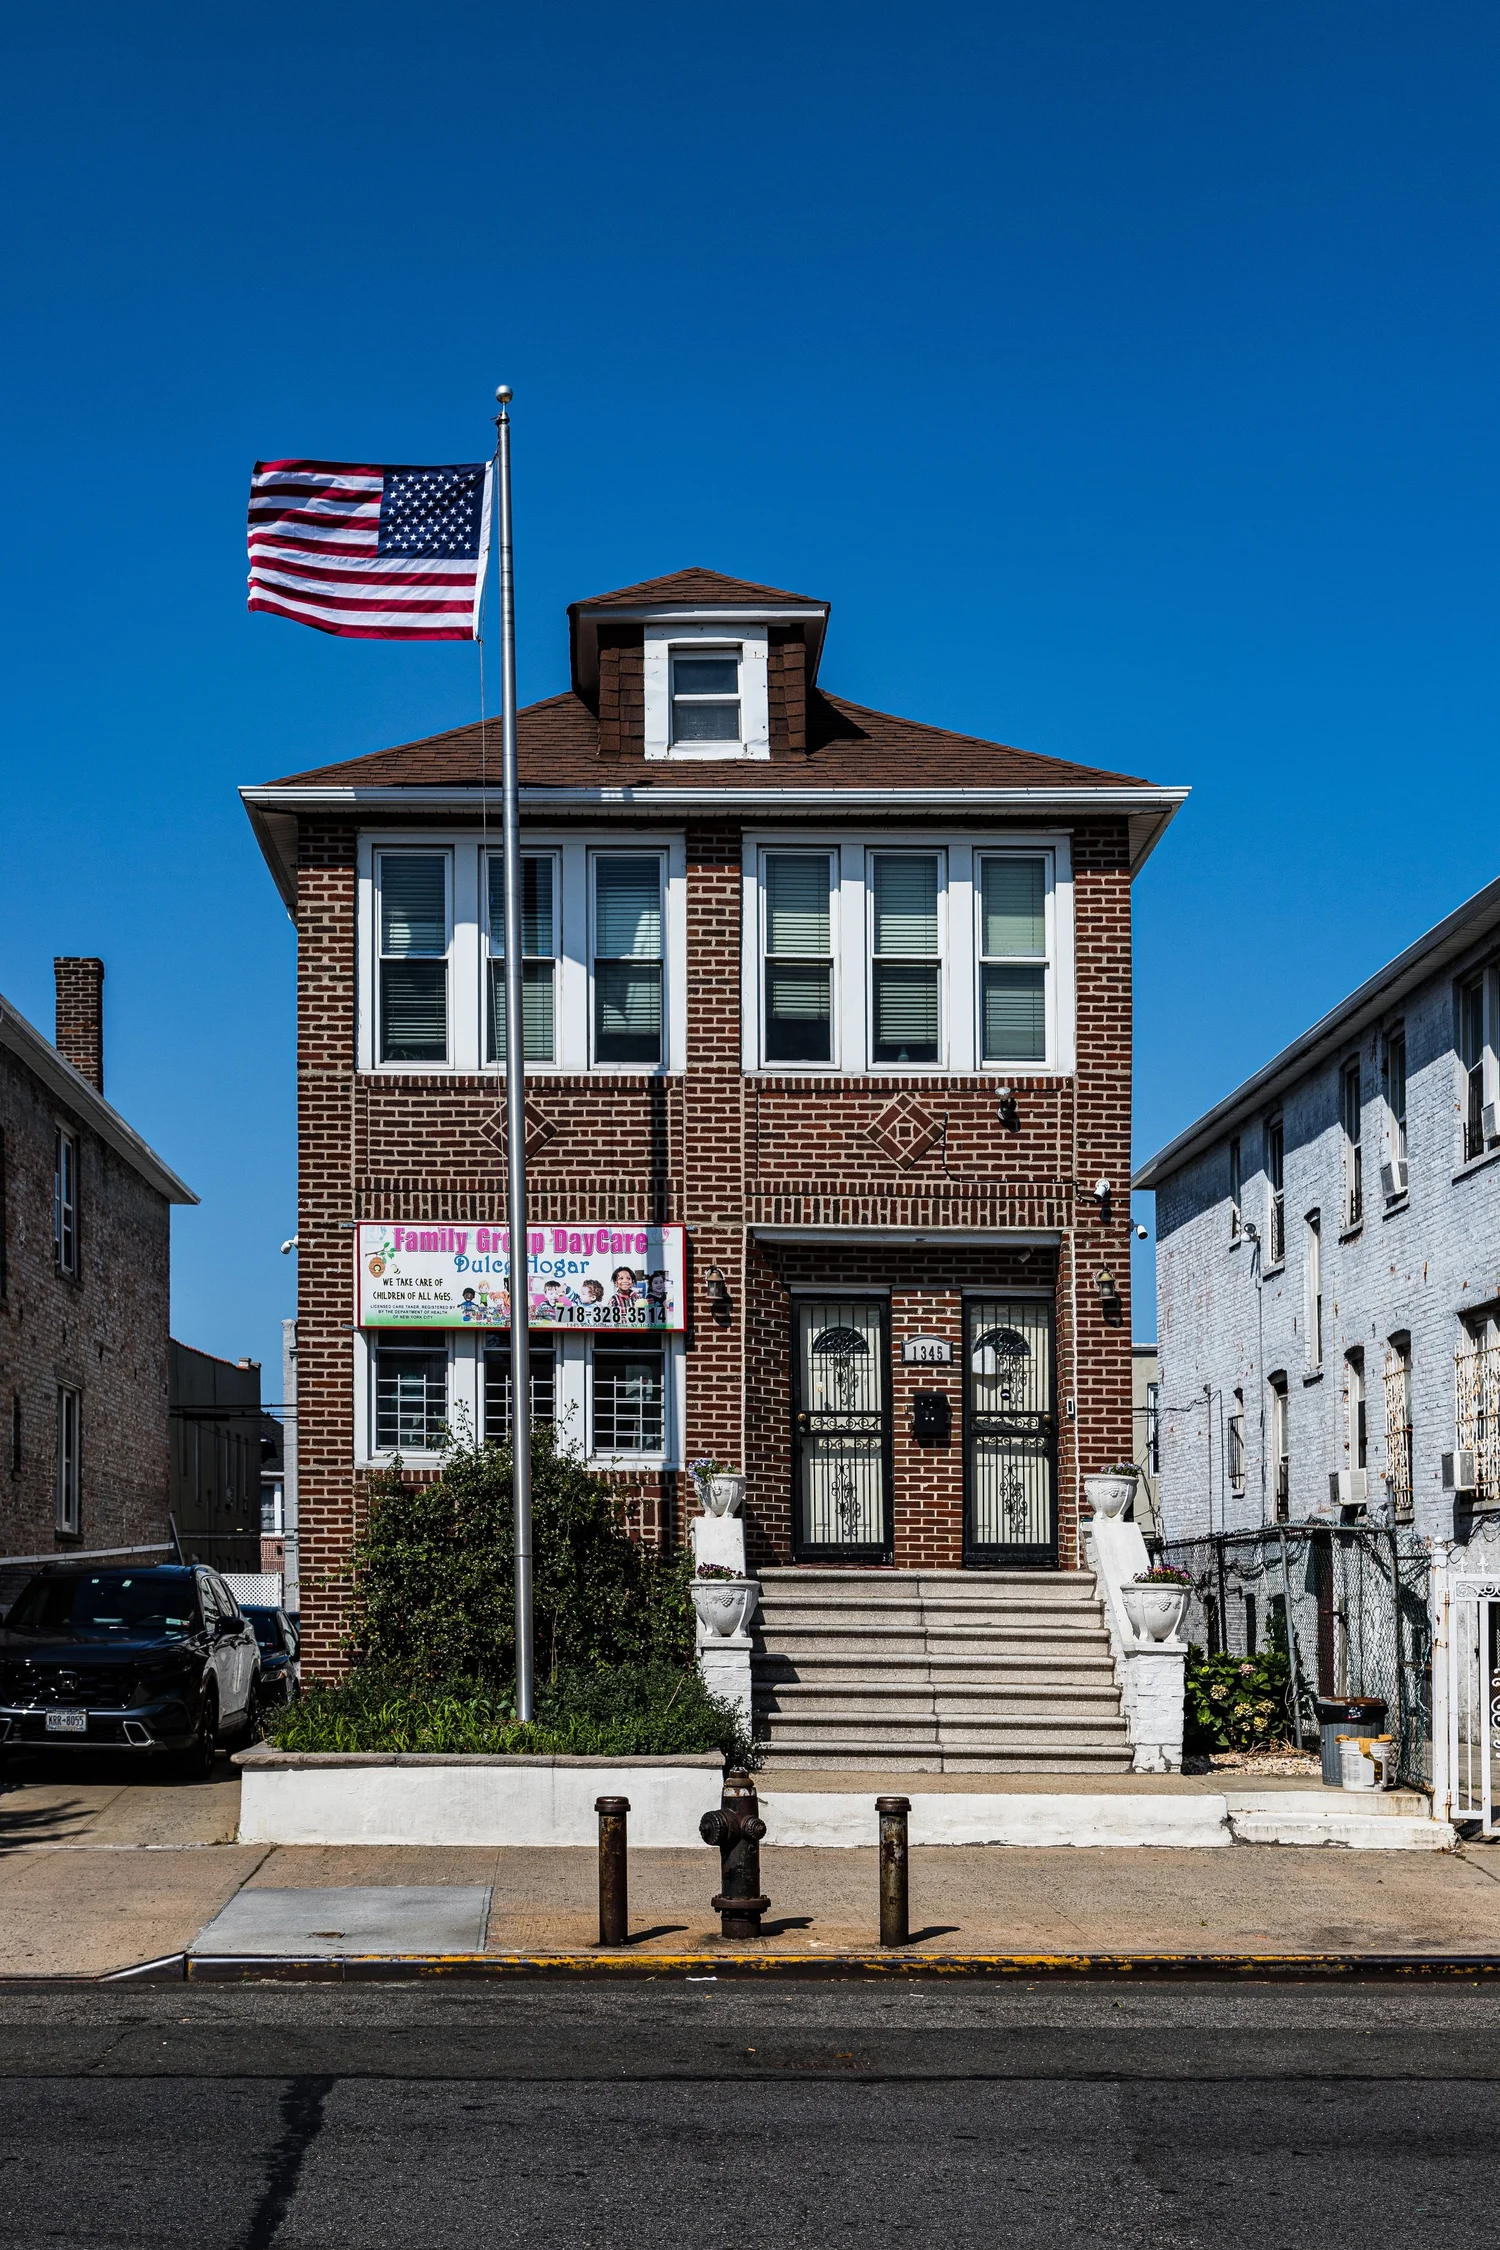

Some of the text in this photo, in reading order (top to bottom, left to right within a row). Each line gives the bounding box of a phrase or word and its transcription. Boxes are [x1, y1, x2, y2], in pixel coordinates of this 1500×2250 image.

[394, 1227, 648, 1256] Family Grop DayCare
[383, 1278, 443, 1287] WE TAKE CARE OF
[372, 1291, 453, 1301] CHILDREN OF ALL AGES.
[556, 1306, 666, 1323] 718-328-3514
[913, 1345, 943, 1360] 1345
